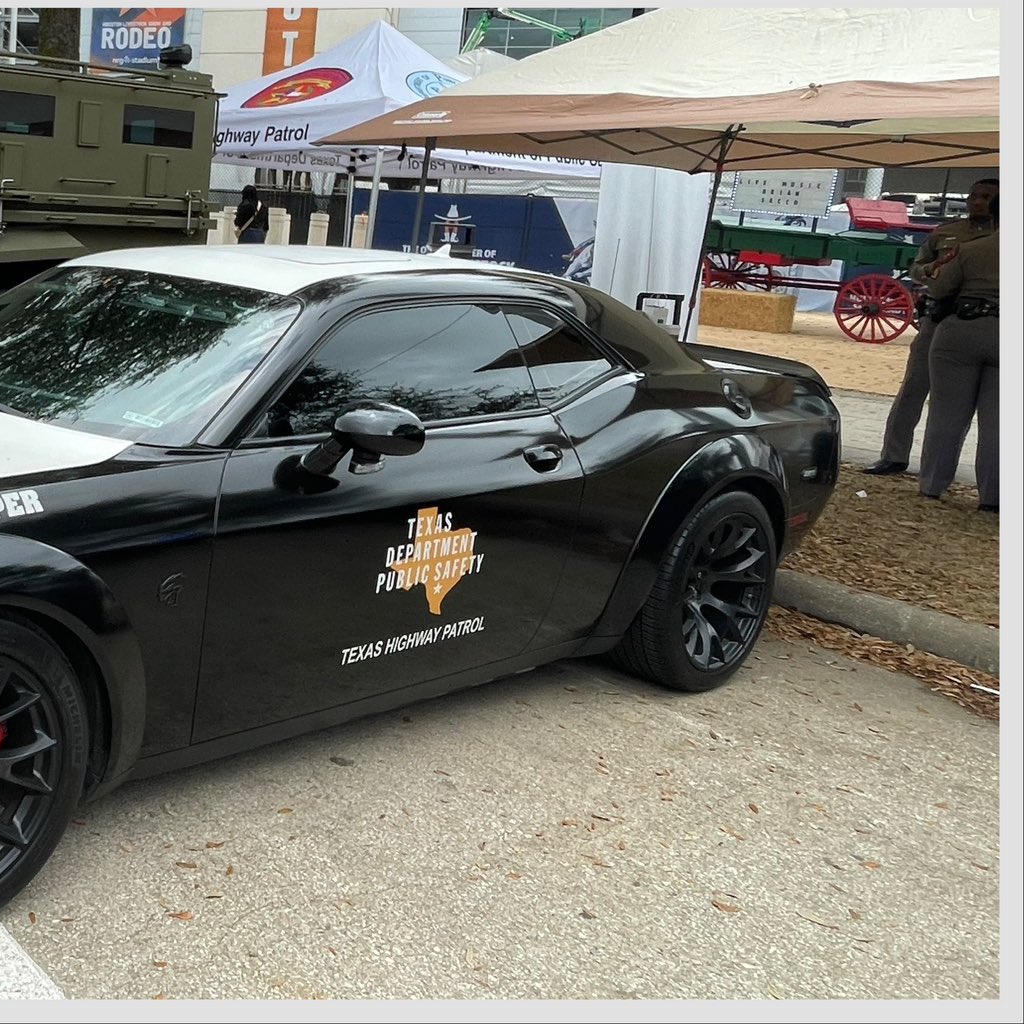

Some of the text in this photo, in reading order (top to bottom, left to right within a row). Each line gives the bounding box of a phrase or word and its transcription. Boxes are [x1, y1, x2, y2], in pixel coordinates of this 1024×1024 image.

[100, 27, 172, 50] RODEO
[264, 124, 309, 143] Patrol
[782, 181, 821, 189] MUSIC
[484, 249, 497, 258] OF
[407, 512, 453, 539] TEXAS
[386, 532, 477, 568] DEPARTMENT
[376, 553, 485, 594] PUBLIC SAFETY
[341, 616, 485, 665] TEXAS HIGHWAY PATROL
